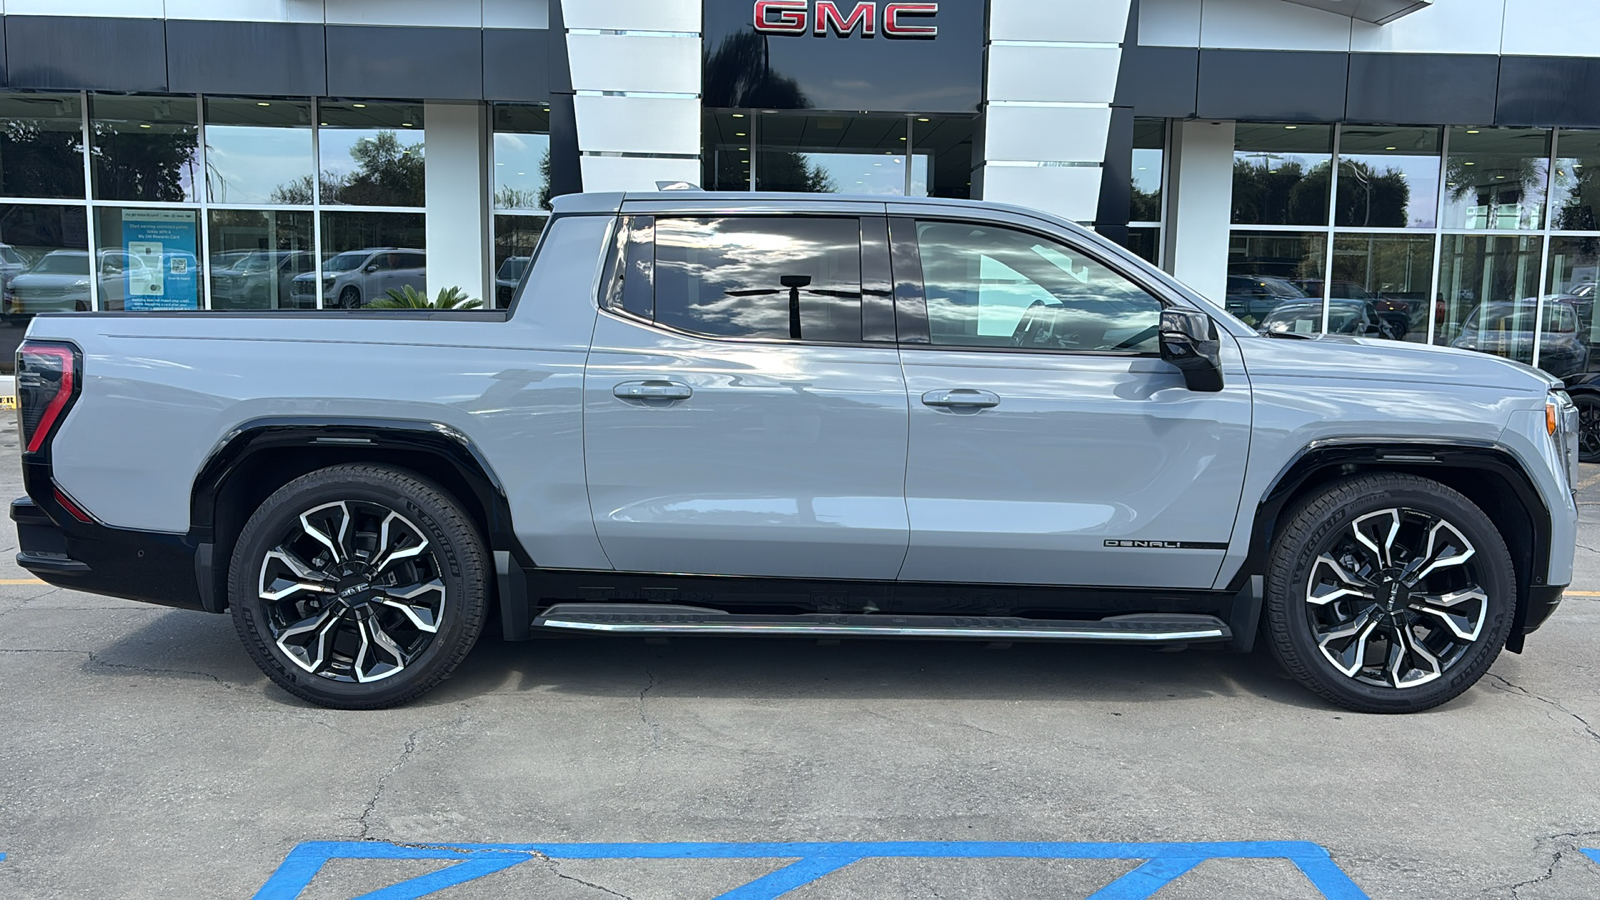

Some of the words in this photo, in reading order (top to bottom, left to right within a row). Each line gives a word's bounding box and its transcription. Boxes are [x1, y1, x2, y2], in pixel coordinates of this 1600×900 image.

[753, 0, 939, 36] GMC
[422, 515, 460, 574] MICHELIN
[1105, 540, 1181, 548] DENALI
[1300, 510, 1345, 566] MICHELIN
[340, 583, 370, 598] GMC
[1386, 582, 1400, 611] GMC
[244, 611, 282, 668] MICHELIN
[1454, 632, 1497, 686] MICHELIN
